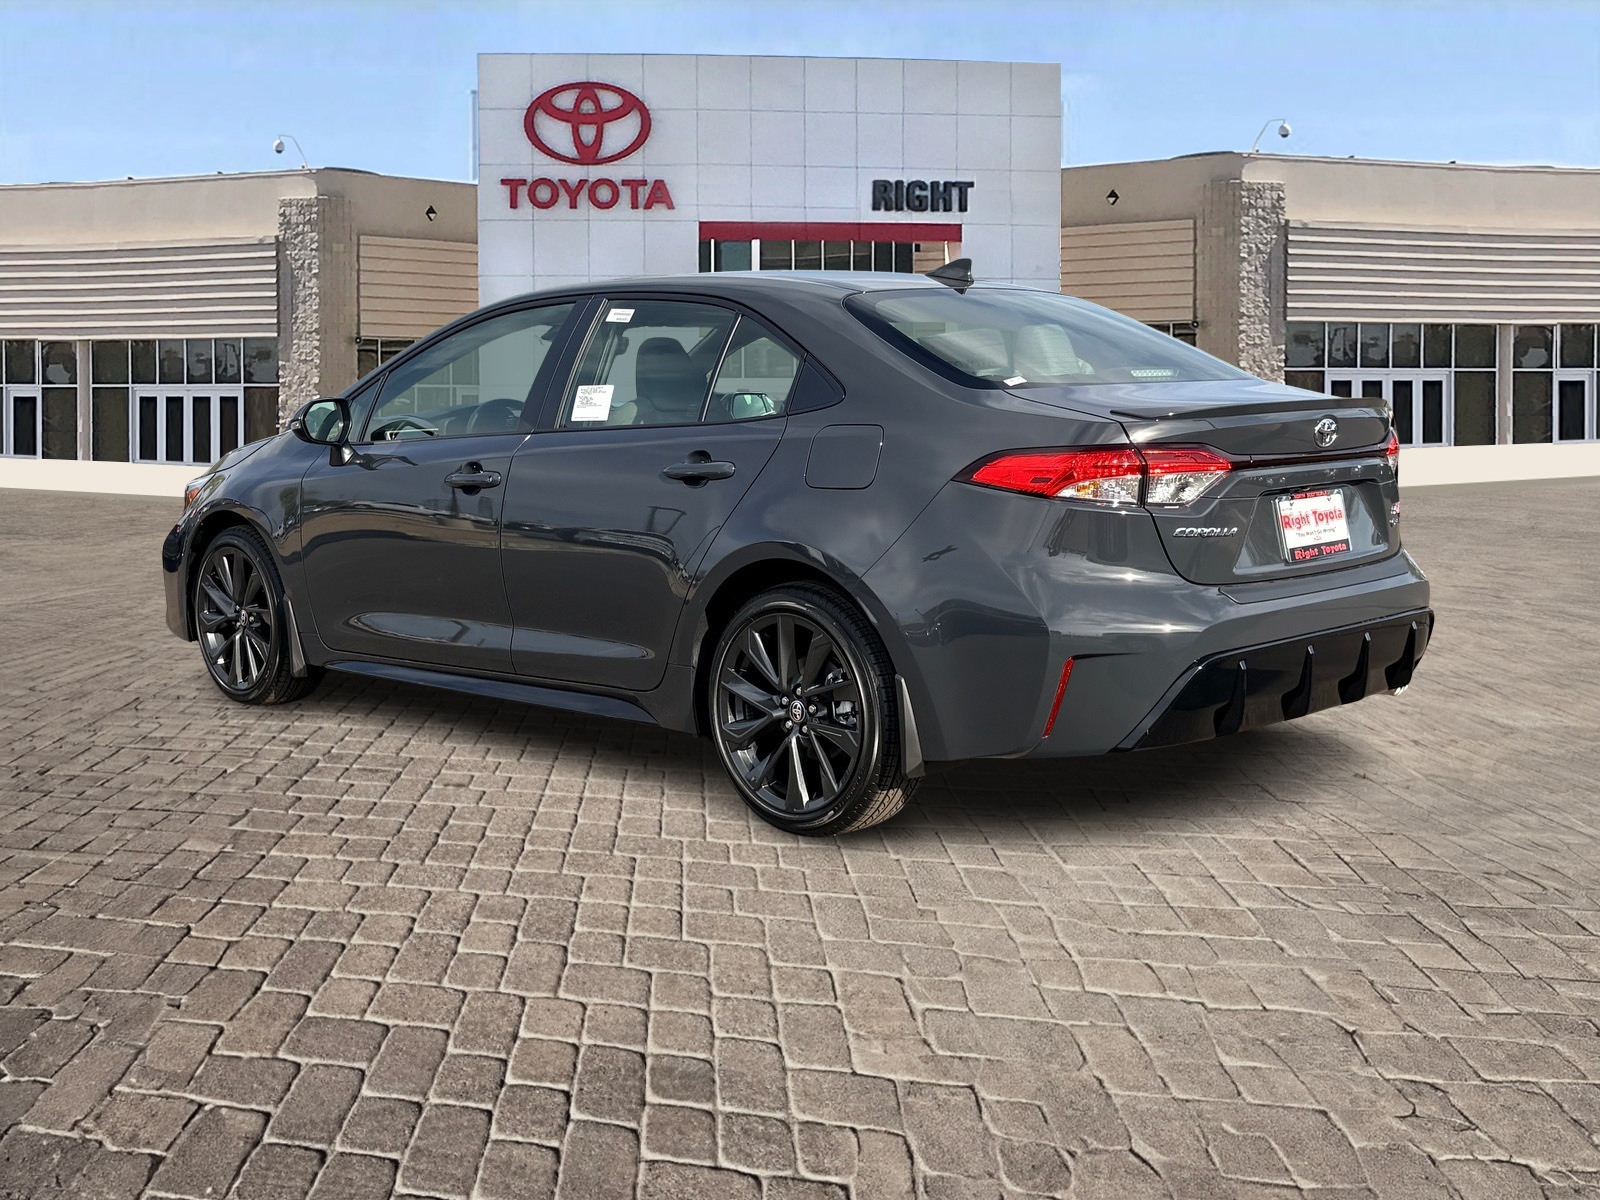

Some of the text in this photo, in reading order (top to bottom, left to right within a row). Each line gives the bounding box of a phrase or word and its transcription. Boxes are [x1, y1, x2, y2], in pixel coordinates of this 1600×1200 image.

[500, 178, 675, 210] TOYOTA
[872, 180, 975, 212] RIGHT
[1282, 507, 1343, 530] Right Toyota
[1173, 527, 1238, 537] COROLLA
[1295, 543, 1347, 559] Right Toyota
